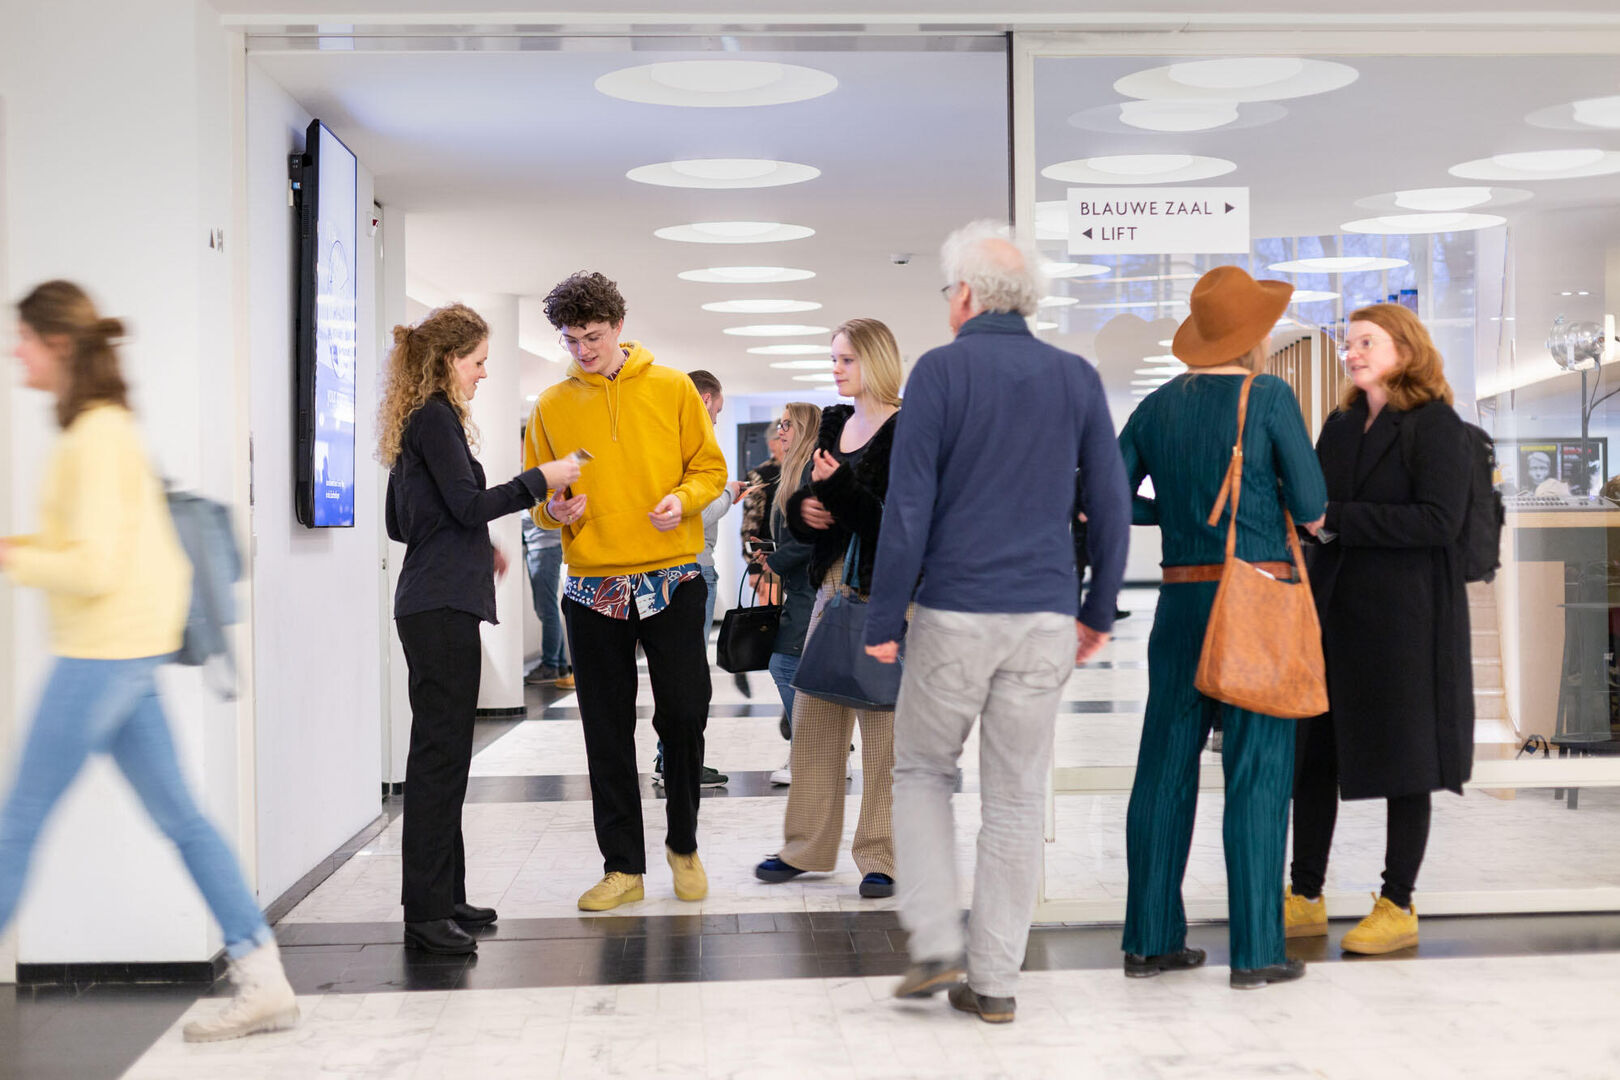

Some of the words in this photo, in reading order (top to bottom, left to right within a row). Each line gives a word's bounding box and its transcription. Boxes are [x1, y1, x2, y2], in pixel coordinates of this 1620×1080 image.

[1080, 201, 1158, 215] BLAUWE
[1165, 201, 1212, 215] ZAAL
[1101, 226, 1138, 240] LIFT
